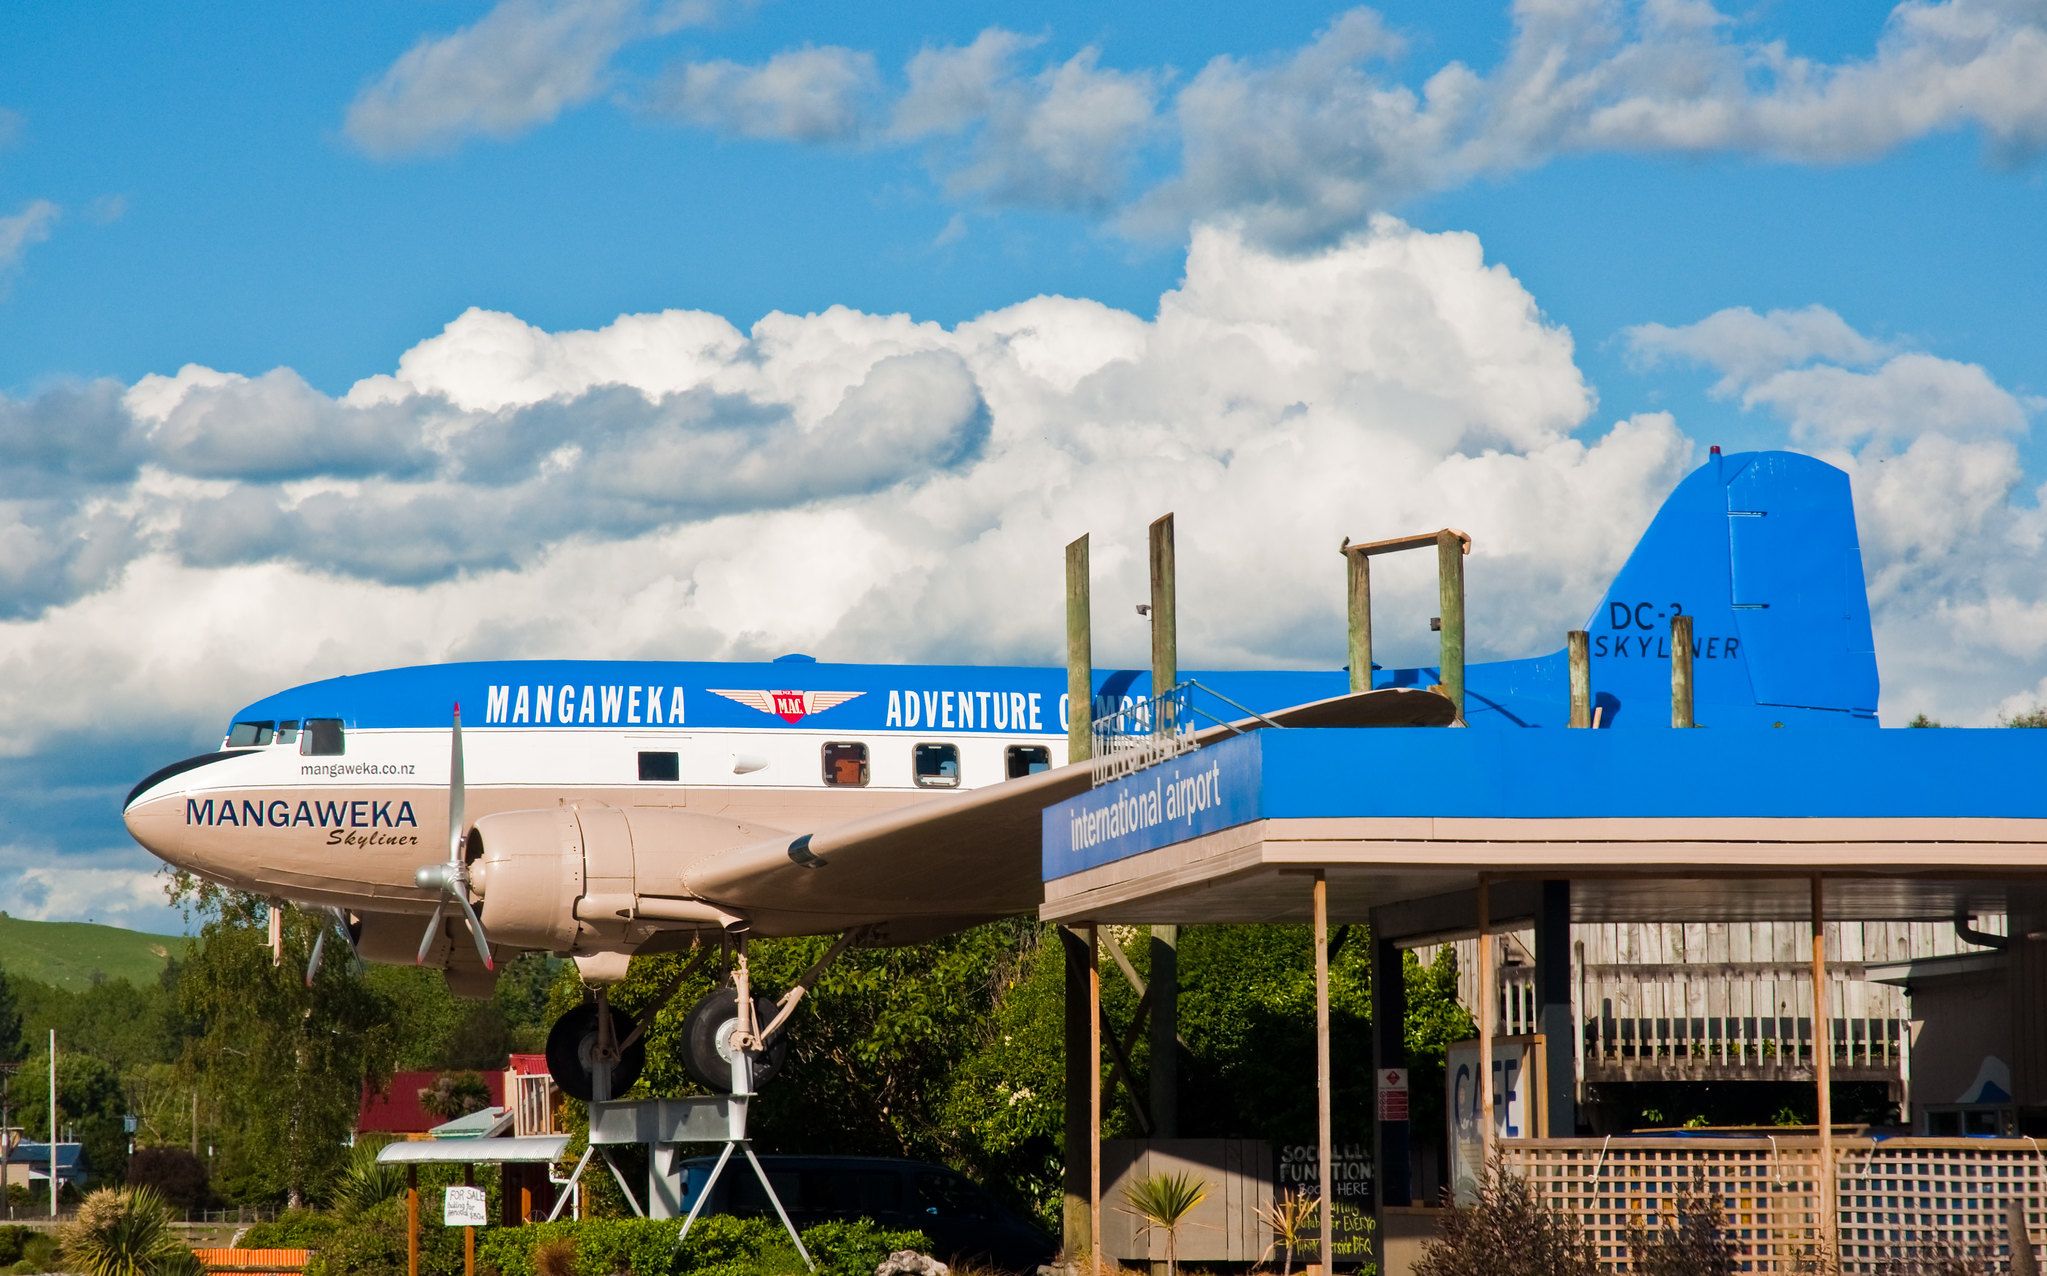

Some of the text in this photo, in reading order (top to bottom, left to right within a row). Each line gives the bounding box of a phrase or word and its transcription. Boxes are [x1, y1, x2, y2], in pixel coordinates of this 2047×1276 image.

[1594, 635, 1740, 660] SKYLNER
[485, 684, 685, 724] MANGAWEKA
[777, 698, 804, 714] MAC
[885, 690, 1185, 732] ADVENTURE CMPA
[301, 762, 416, 778] mangaweka.co.nz
[186, 798, 418, 828] MANGAWEKA
[1070, 759, 1221, 851] international airport
[326, 829, 418, 850] Skyliner
[1281, 1144, 1343, 1162] SOCL
[1280, 1162, 1375, 1182] FUNTION
[450, 1189, 484, 1201] FOR SALE
[1298, 1181, 1369, 1196] BOO HERE
[1343, 1215, 1376, 1234] EVERYO
